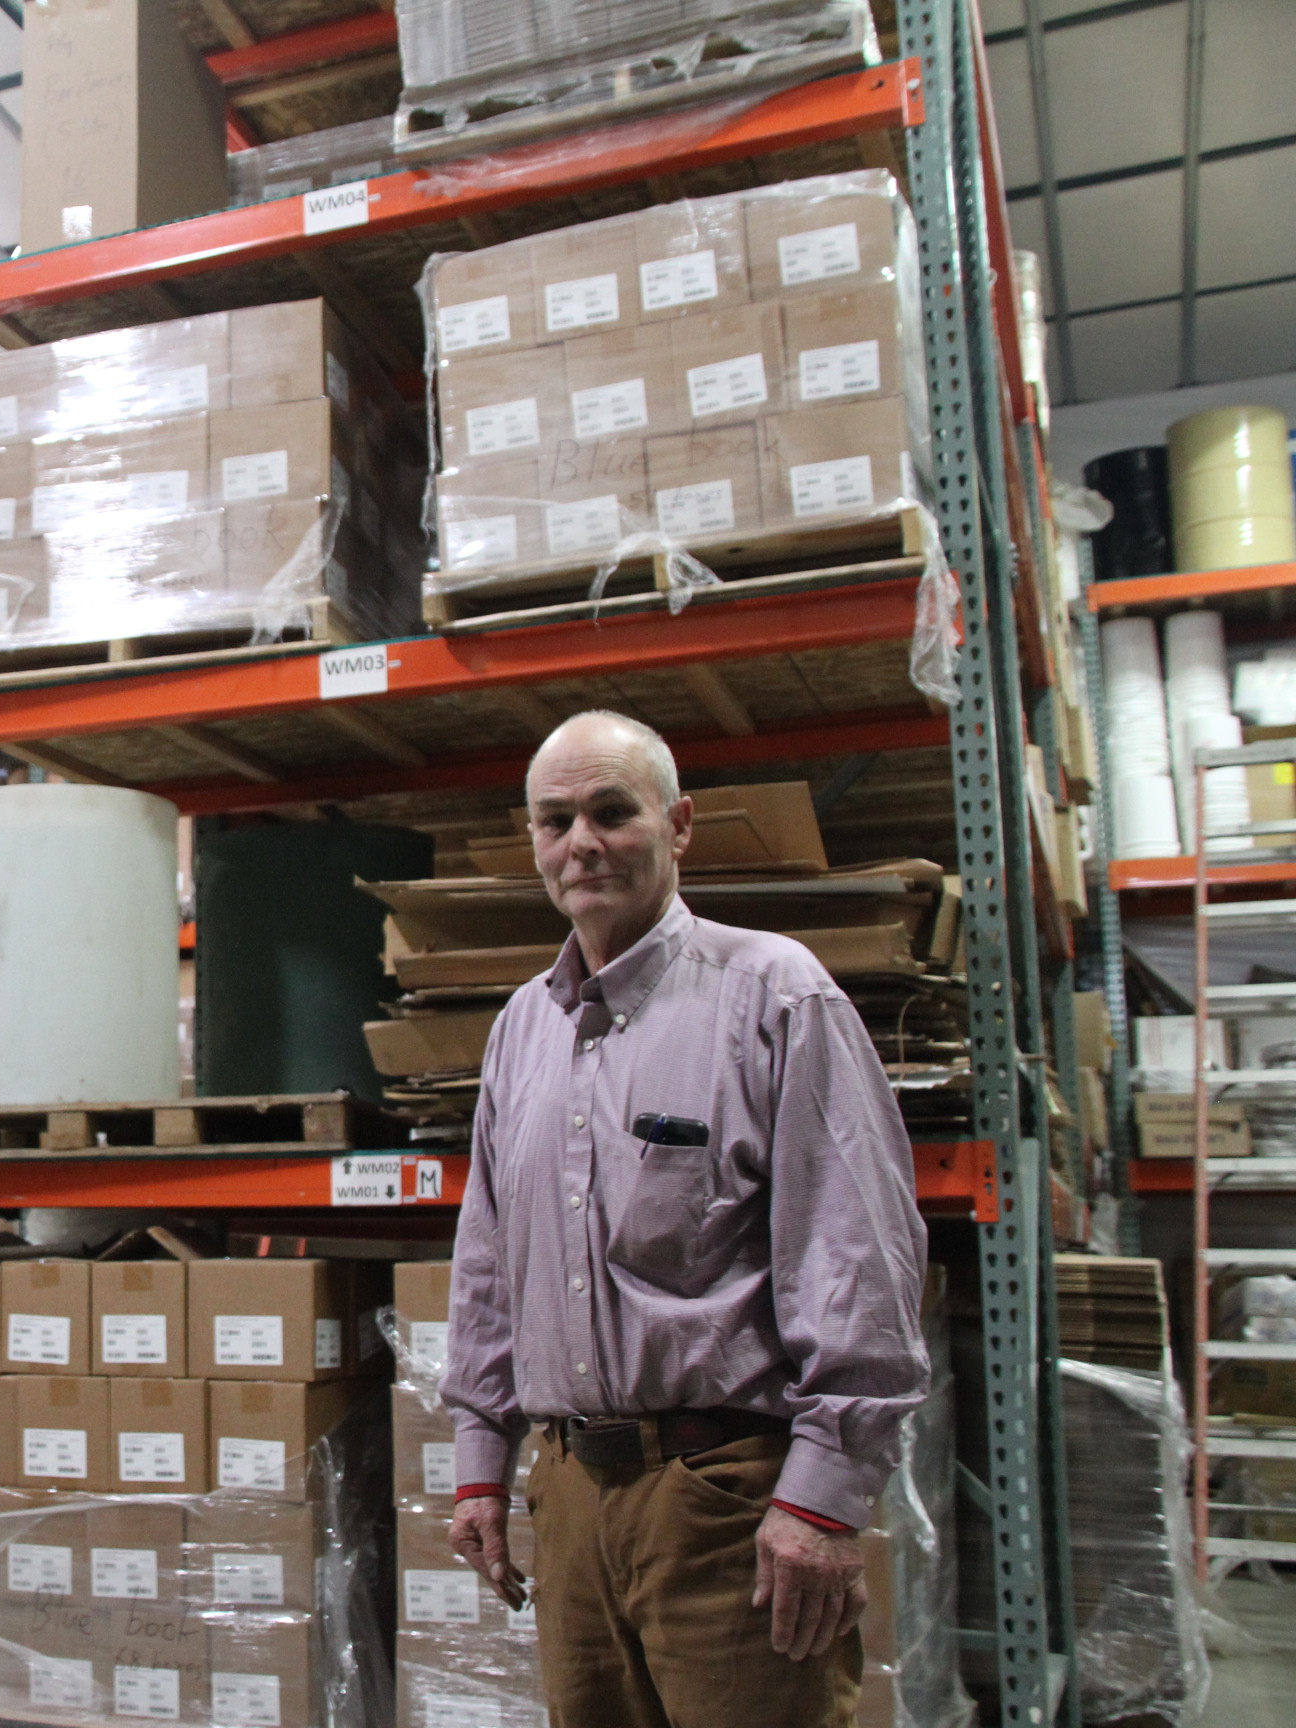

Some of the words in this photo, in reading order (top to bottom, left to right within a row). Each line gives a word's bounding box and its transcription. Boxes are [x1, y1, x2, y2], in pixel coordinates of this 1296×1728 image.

[308, 188, 365, 213] WM04
[550, 438, 648, 490] Blue
[324, 654, 385, 676] WM03
[357, 1162, 401, 1175] WM02
[336, 1186, 379, 1198] WM01
[420, 1169, 440, 1198] M
[28, 1585, 92, 1636] Blue
[126, 1584, 200, 1642] book
